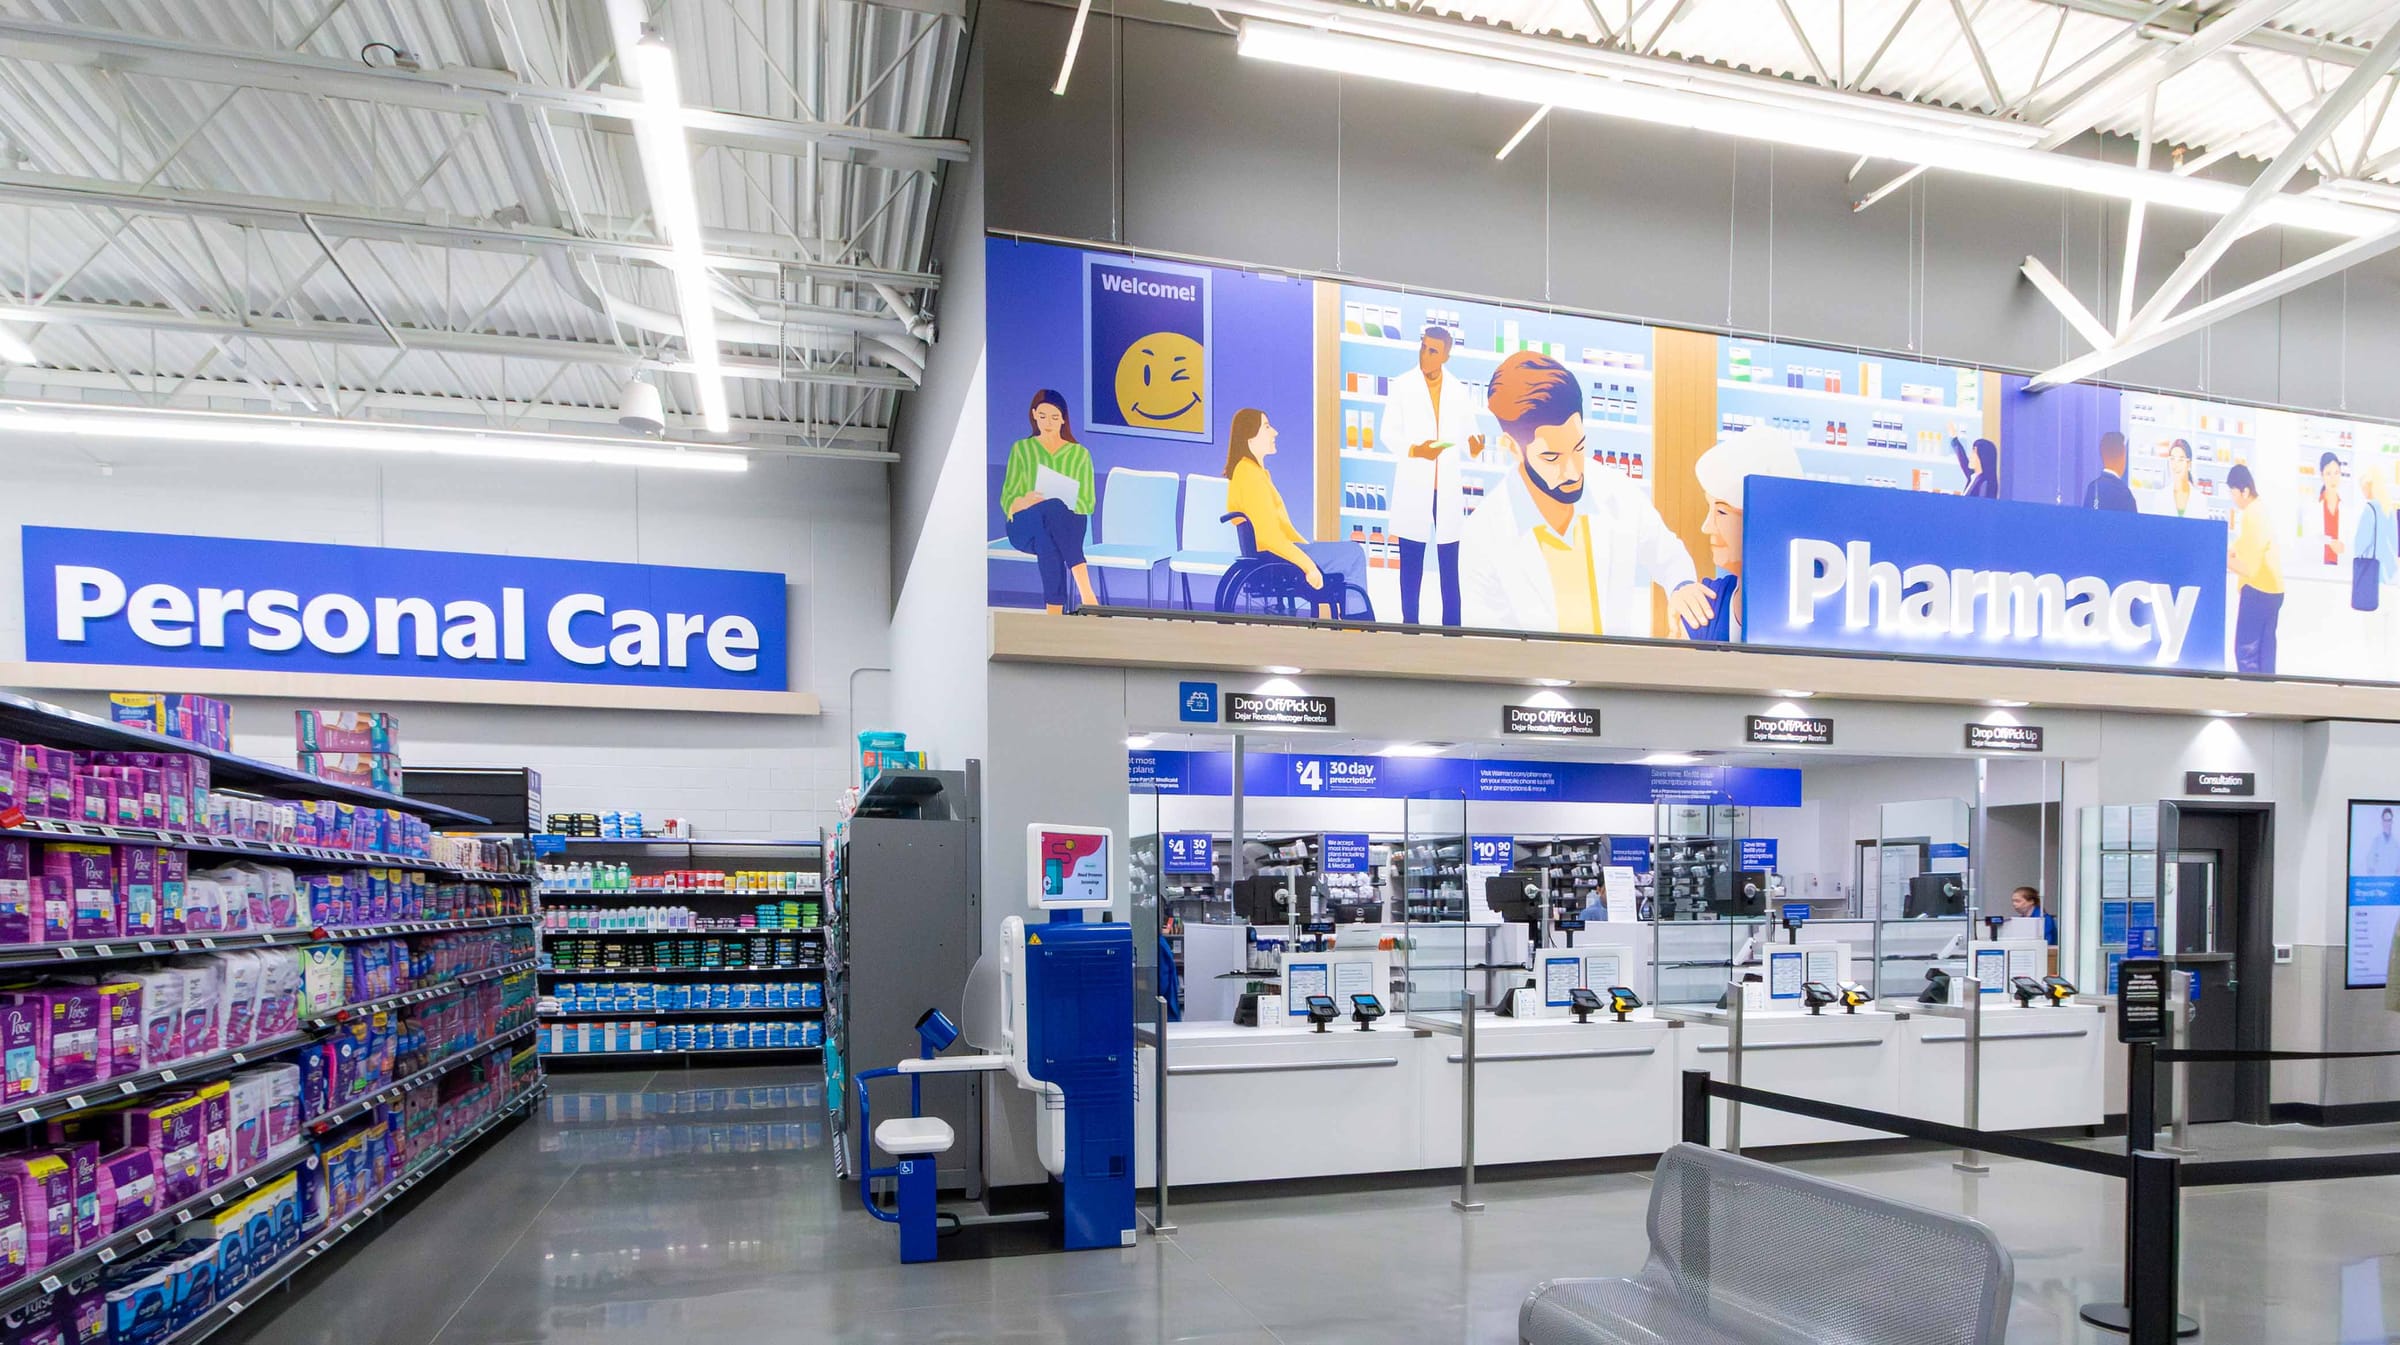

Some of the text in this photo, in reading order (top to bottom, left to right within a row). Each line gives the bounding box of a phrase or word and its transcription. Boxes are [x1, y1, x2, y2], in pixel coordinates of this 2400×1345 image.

[1101, 273, 1196, 301] Welcome!
[1788, 537, 2201, 665] Pharmacy
[54, 564, 760, 672] Personal Care
[1234, 697, 1327, 715] Drop Off/Pick Up
[1234, 712, 1252, 721] Dejar
[1511, 709, 1594, 726] Drop Off/Pick Up
[1754, 719, 1827, 735] Drop Off/Pick Up
[1972, 727, 2038, 743] Drop Off/Pick Up
[1135, 757, 1156, 765] most
[1329, 761, 1374, 777] 30 day
[1132, 765, 1155, 775] plans
[1296, 760, 1323, 791] $4
[2198, 774, 2243, 785] Consultation
[1168, 838, 1186, 855] $4
[1192, 839, 1207, 849] 30
[1473, 841, 1495, 857] $10
[1498, 841, 1511, 851] 90
[82, 857, 104, 880] Poise
[133, 849, 151, 872] Poise
[68, 996, 89, 1020] Poise
[8, 1010, 32, 1036] Poise
[172, 1116, 193, 1142] Poise
